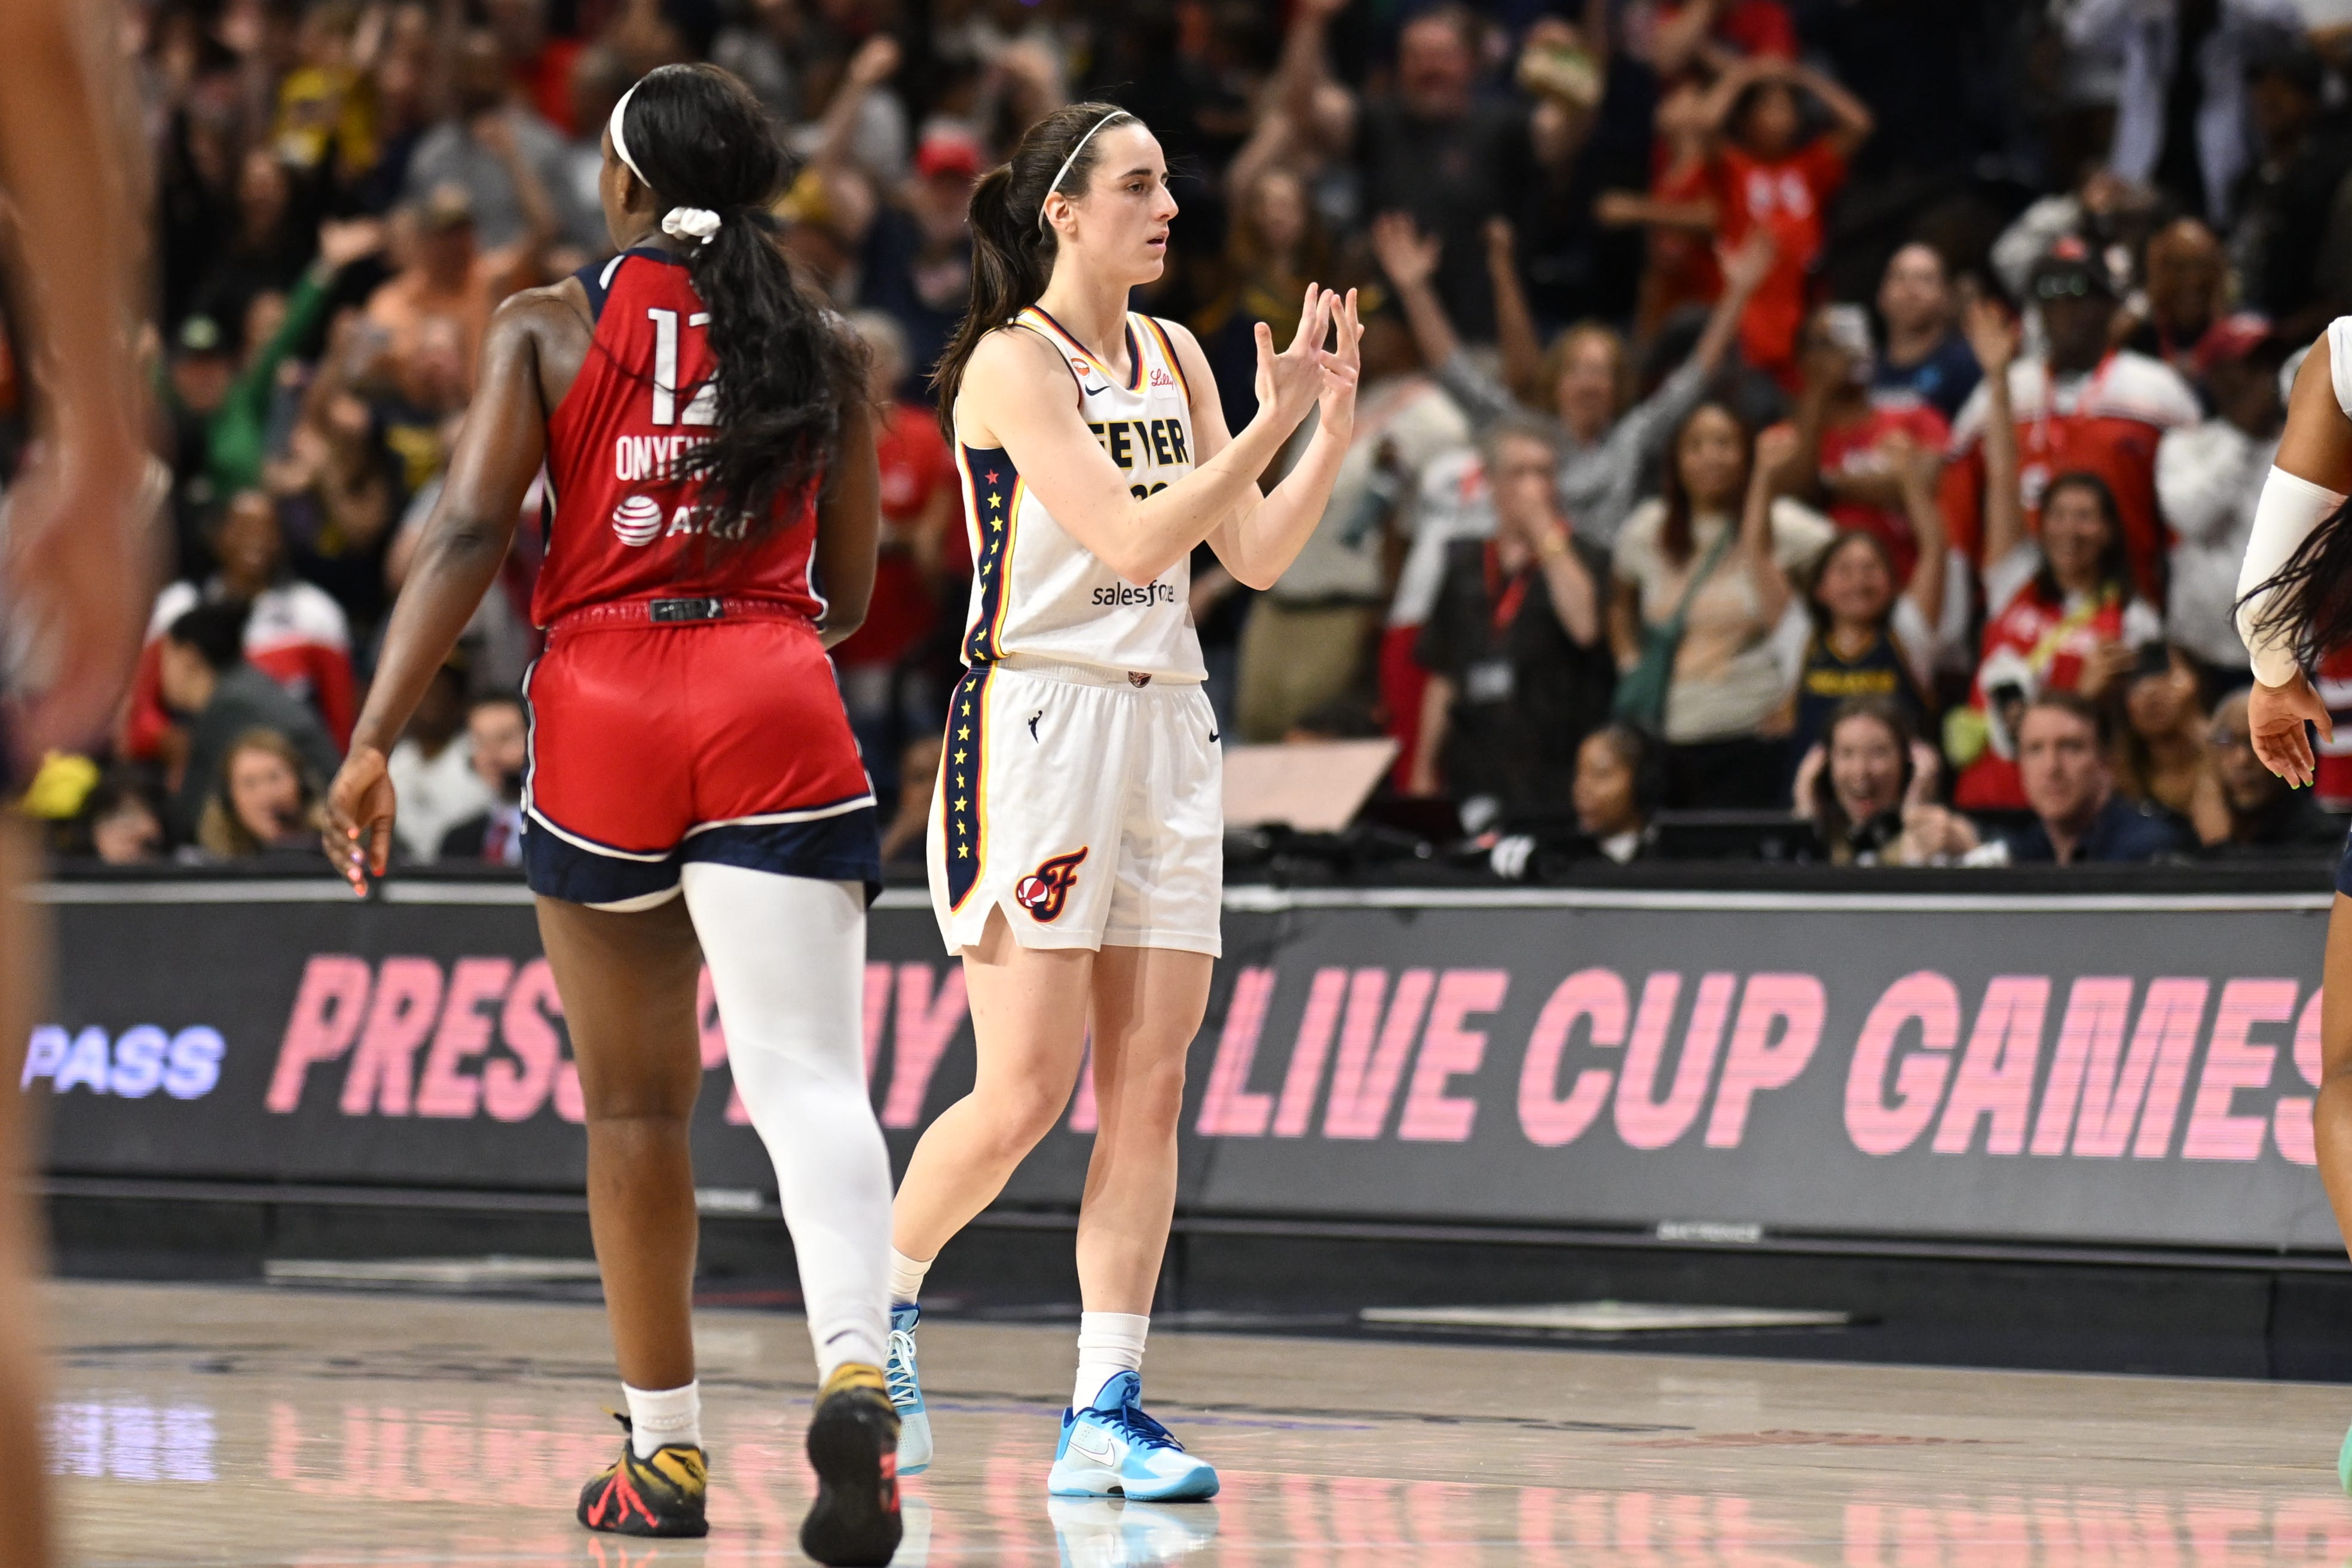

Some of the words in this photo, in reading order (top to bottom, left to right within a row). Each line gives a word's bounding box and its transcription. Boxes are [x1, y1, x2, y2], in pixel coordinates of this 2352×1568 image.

[1150, 368, 1174, 391] Lilly
[20, 1024, 227, 1100] PASS
[264, 953, 587, 1125] PRES
[1195, 966, 1510, 1142] LIVE
[1517, 966, 1827, 1150] CUP
